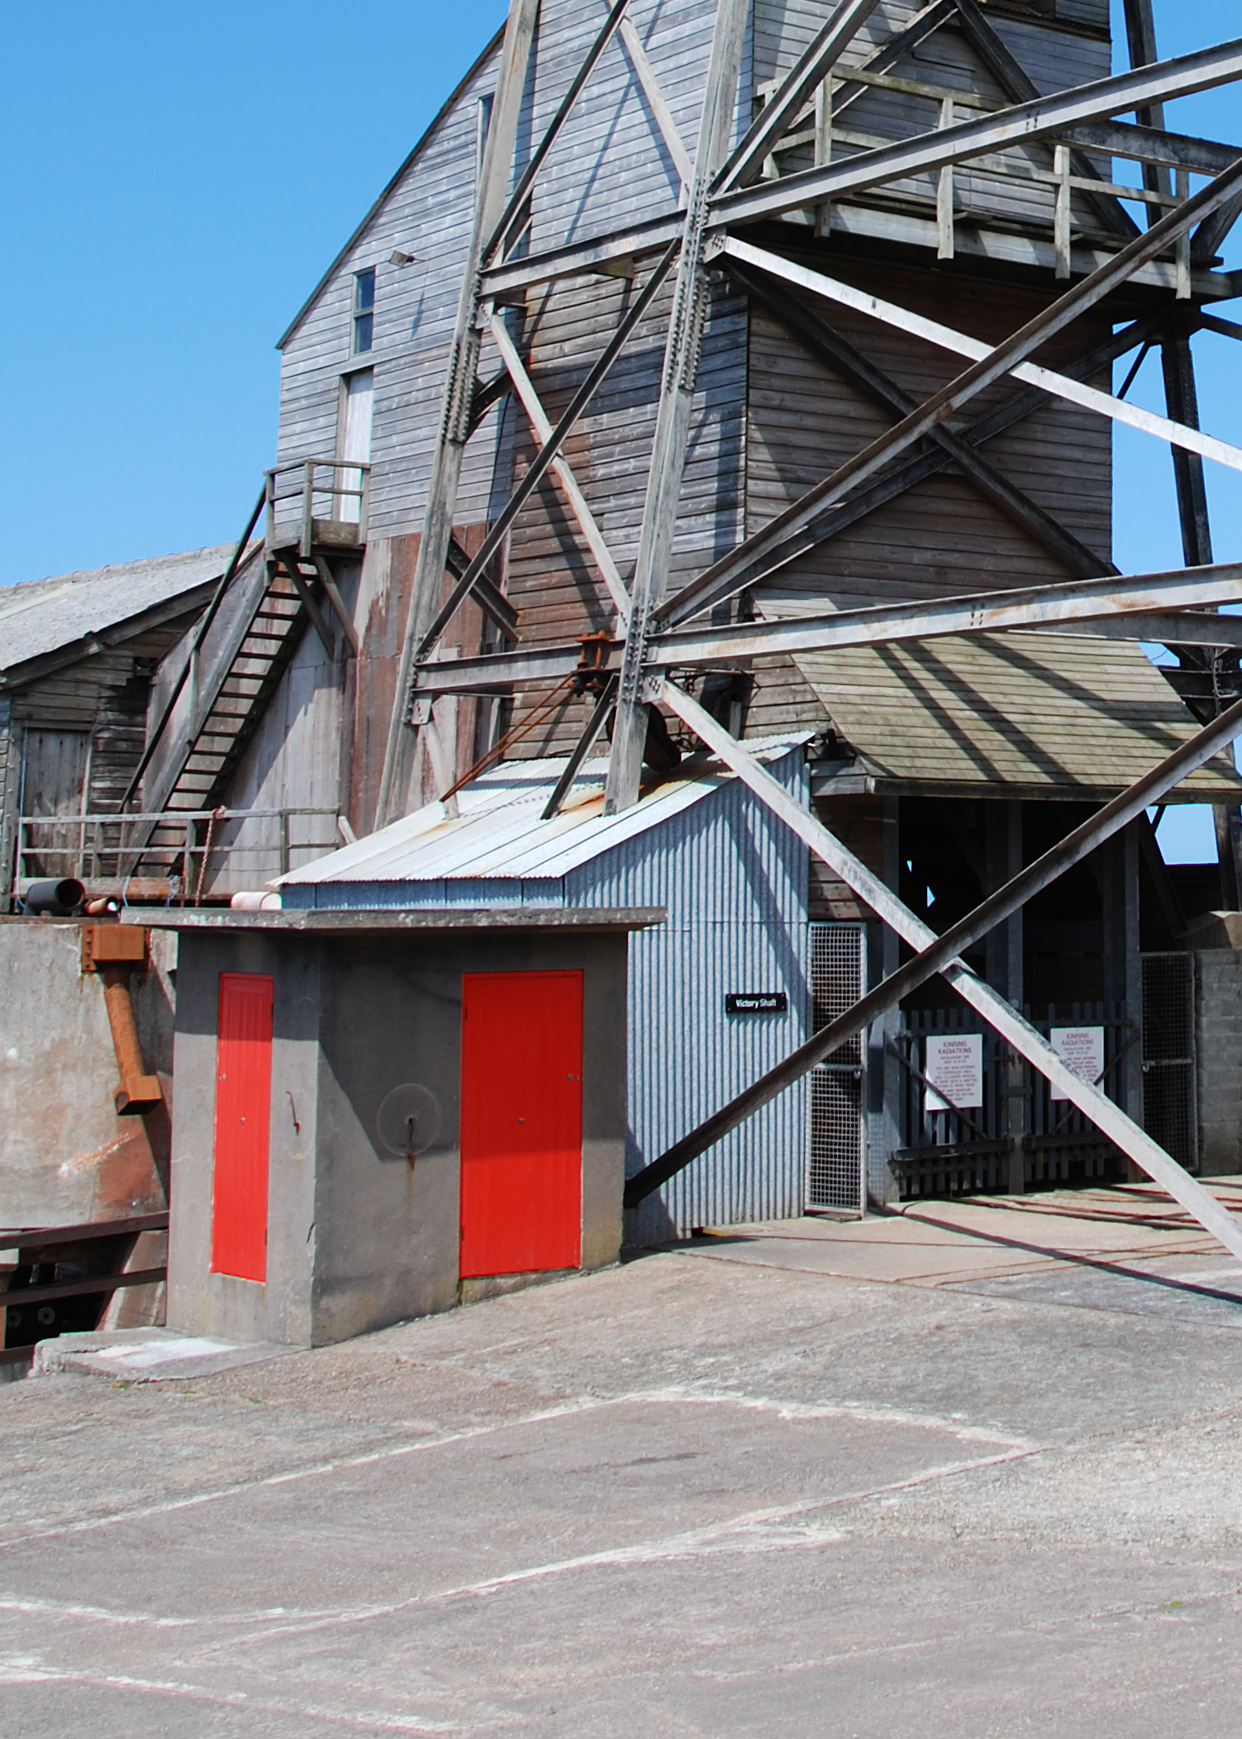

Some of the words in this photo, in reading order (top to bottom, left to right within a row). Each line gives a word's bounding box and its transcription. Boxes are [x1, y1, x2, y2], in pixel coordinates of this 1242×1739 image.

[735, 998, 759, 1009] Victory
[760, 998, 777, 1007] Shaft
[1066, 1032, 1090, 1040] IONISING
[943, 1040, 967, 1048] IONISING
[1061, 1038, 1094, 1046] RADIATIONS
[938, 1047, 972, 1055] RADIATIONS
